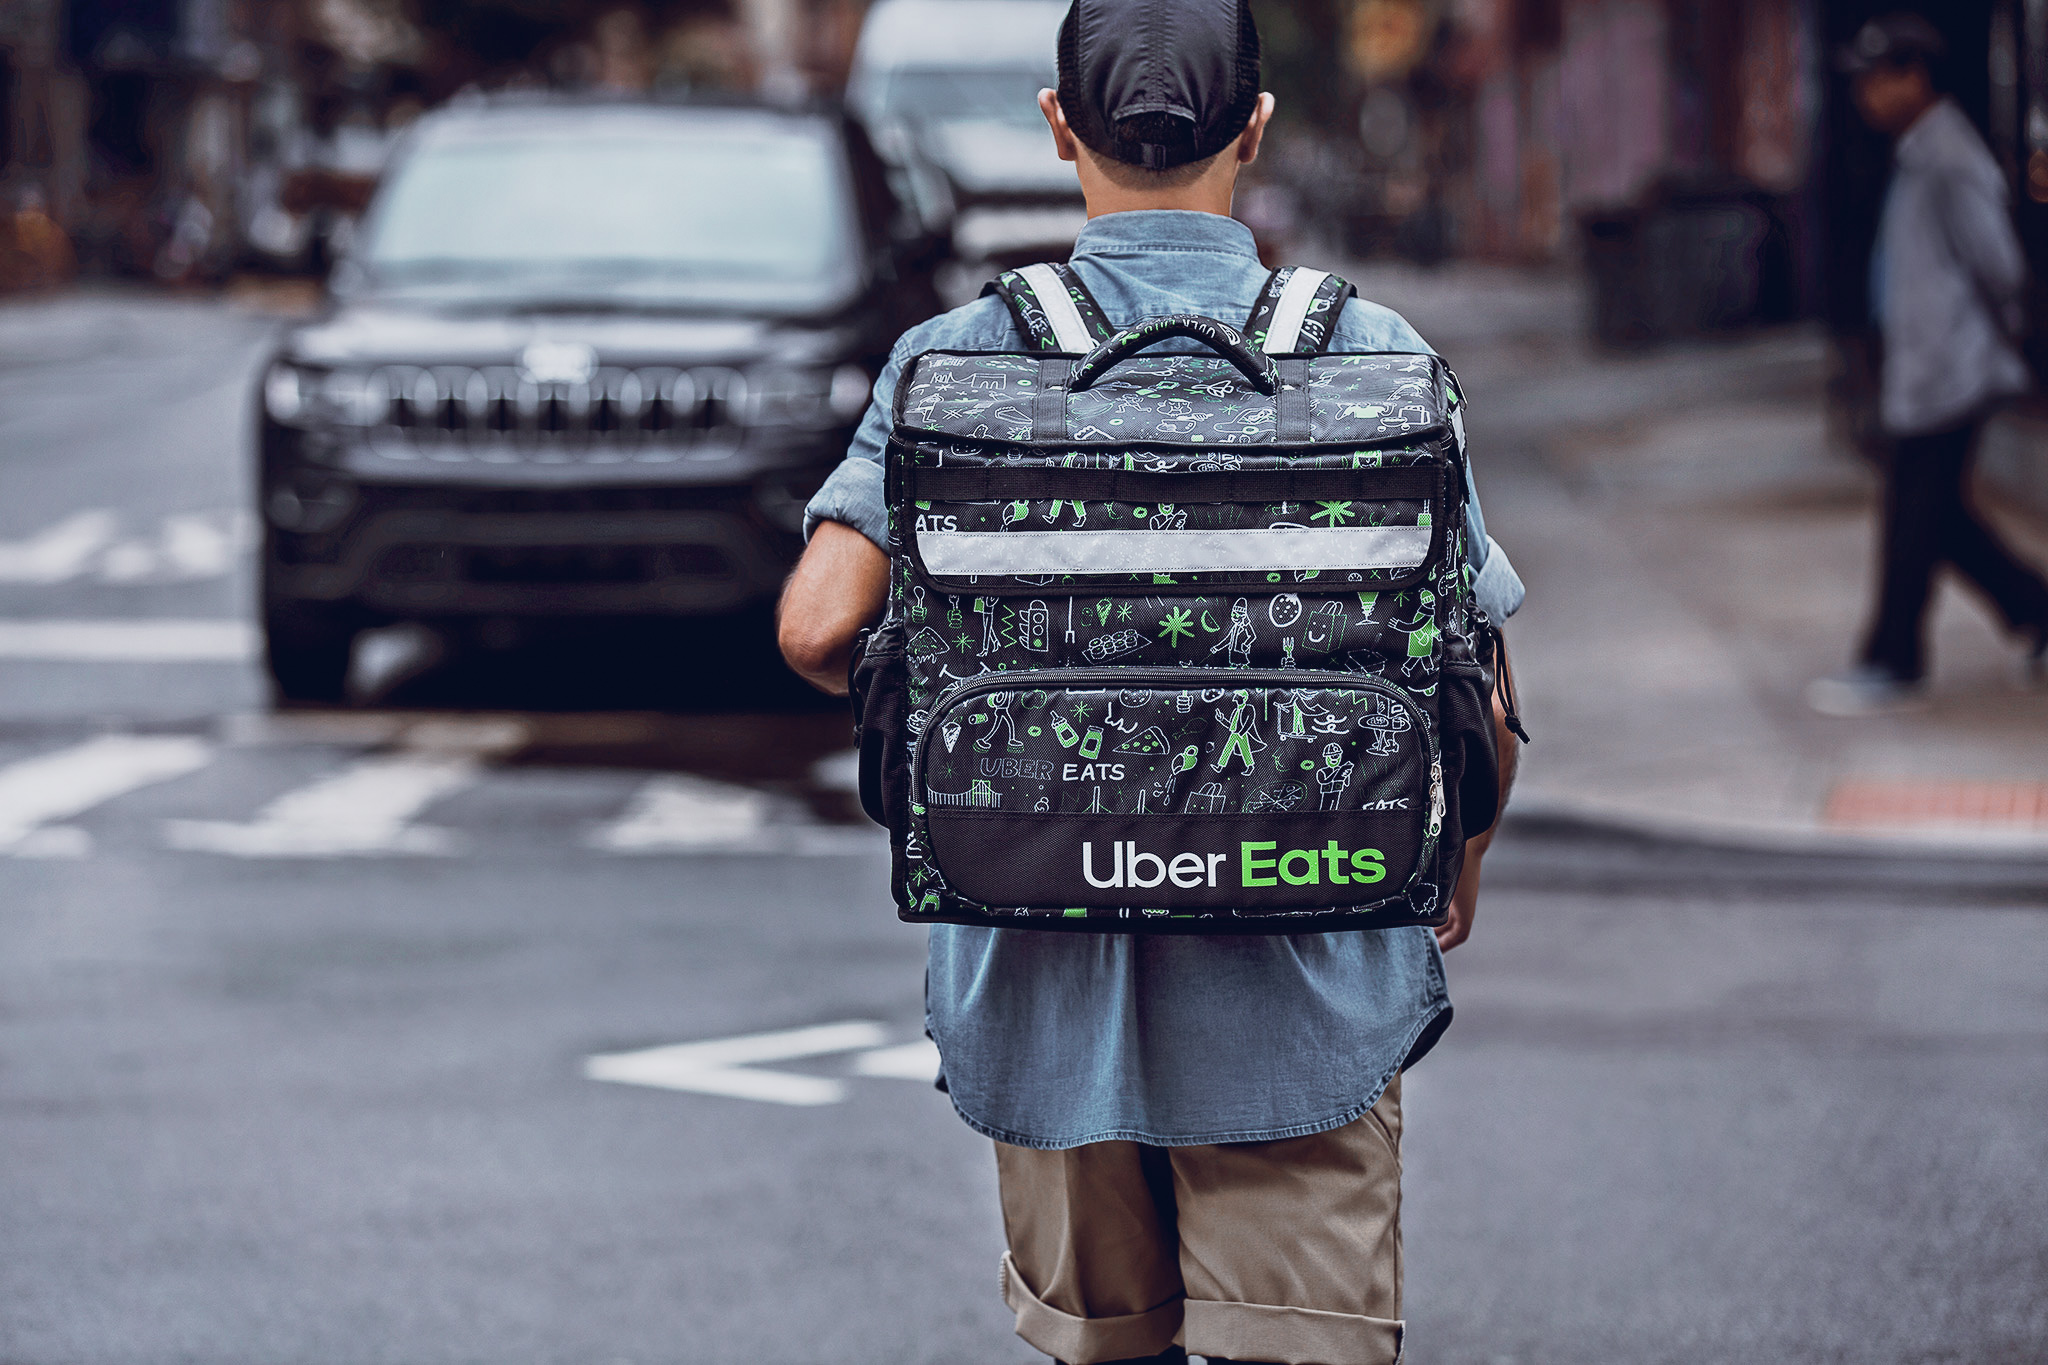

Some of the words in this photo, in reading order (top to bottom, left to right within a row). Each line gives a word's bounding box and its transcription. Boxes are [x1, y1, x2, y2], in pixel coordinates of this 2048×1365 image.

[980, 757, 1054, 780] UBER
[1063, 763, 1125, 781] EATS
[1083, 841, 1226, 888] Uber
[1241, 840, 1386, 887] Eats
